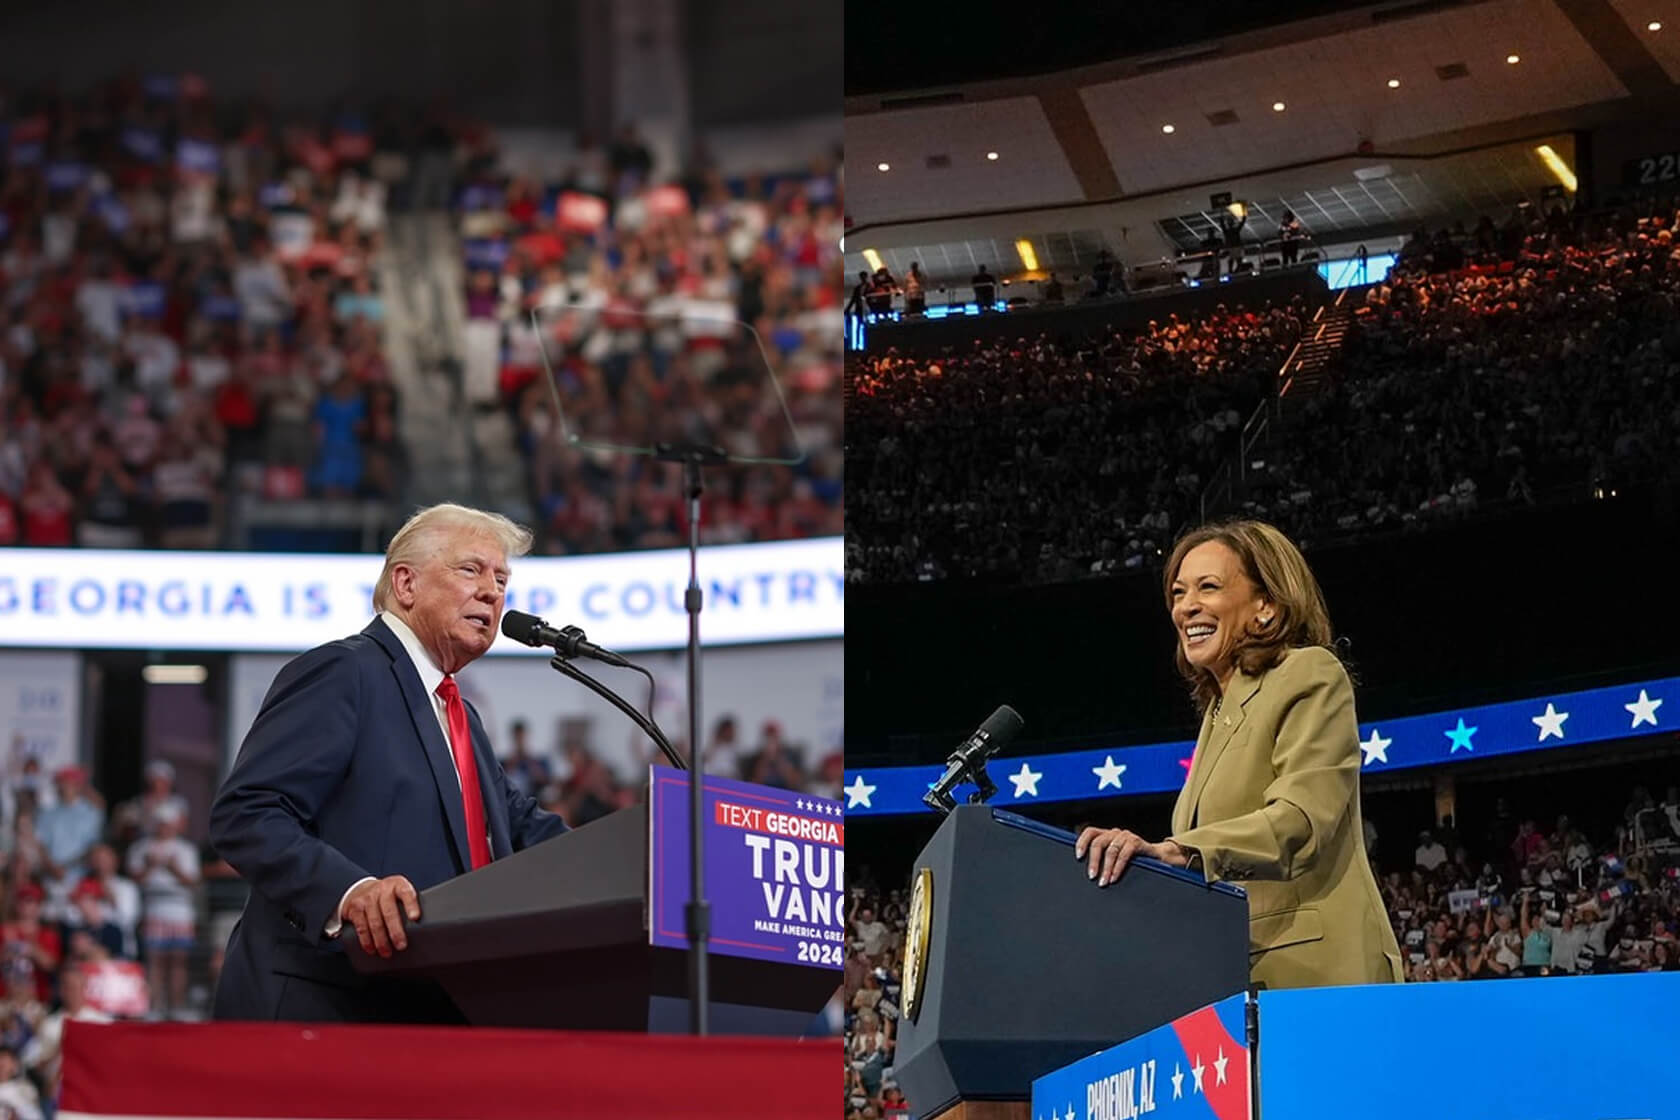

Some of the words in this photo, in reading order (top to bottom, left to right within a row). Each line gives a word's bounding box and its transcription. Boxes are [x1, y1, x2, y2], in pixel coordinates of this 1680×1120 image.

[0, 576, 257, 618] GEORGIA
[282, 583, 332, 618] IS
[580, 569, 844, 620] COUNTRY
[720, 803, 762, 830] TEXT
[766, 812, 839, 843] GEORGIA
[745, 833, 844, 892] TRU
[754, 919, 781, 935] MAKE
[782, 924, 822, 940] AMERICA
[797, 941, 843, 966] 2024
[1087, 1067, 1138, 1120] PHOENIX,
[1139, 1059, 1156, 1114] AZ
